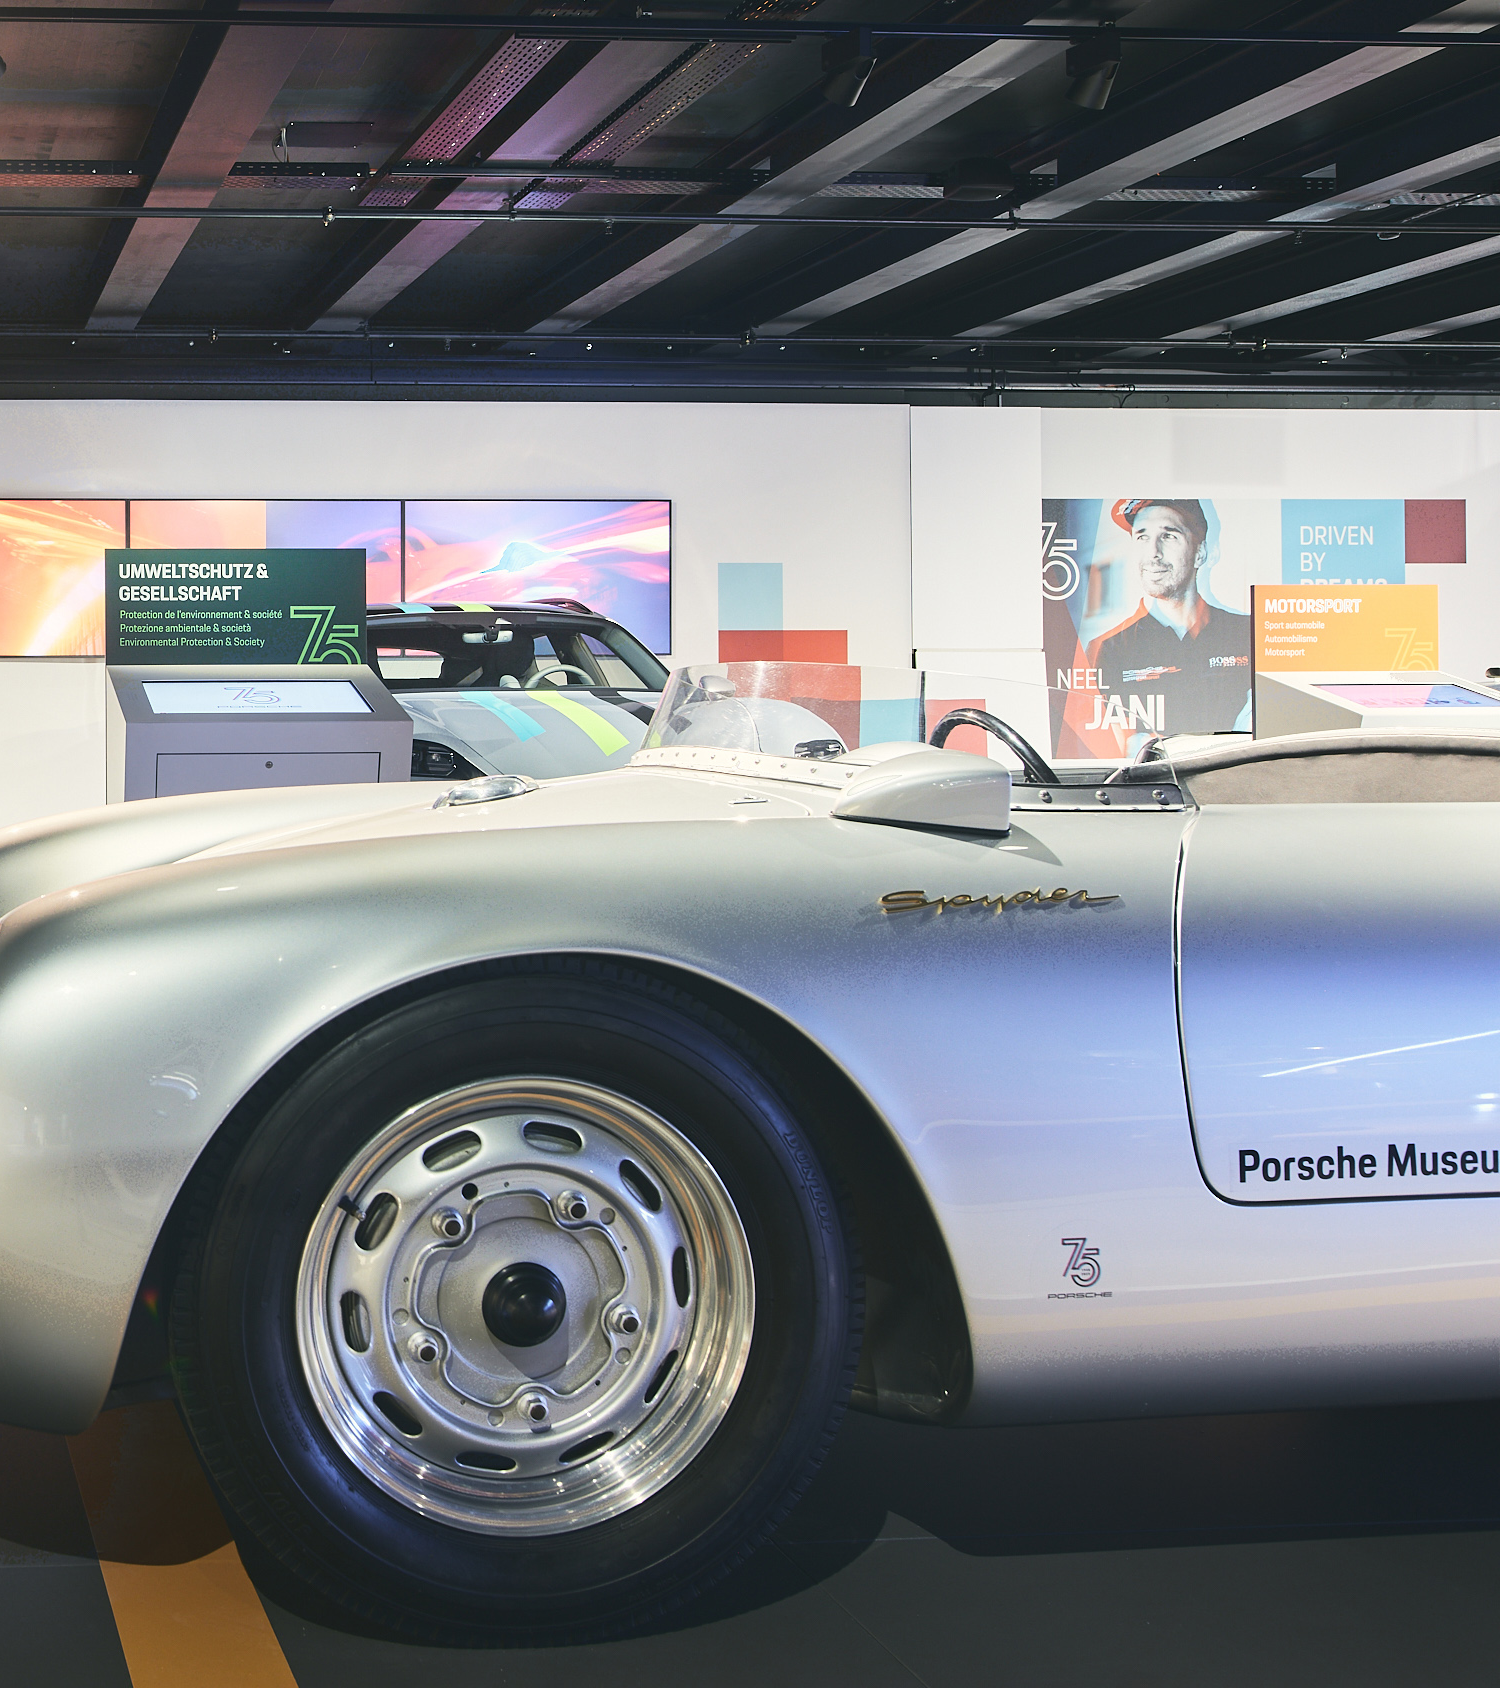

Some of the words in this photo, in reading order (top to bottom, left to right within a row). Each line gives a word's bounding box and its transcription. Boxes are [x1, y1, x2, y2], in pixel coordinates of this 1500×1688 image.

[1299, 525, 1374, 546] DRIVEN
[1300, 552, 1326, 572] BY
[119, 563, 254, 579] UMWELTSCHUTZ
[256, 563, 269, 579] &
[118, 585, 243, 602] GESELLSCHAFT
[119, 609, 163, 619] Protection
[164, 609, 175, 619] de
[177, 609, 242, 619] l'environnement
[244, 609, 251, 619] &
[252, 609, 283, 619] société
[1264, 598, 1362, 614] MOTORSPORT
[119, 623, 164, 633] Protezione
[165, 623, 212, 633] ambientale
[213, 623, 220, 633] &
[221, 623, 252, 633] società
[1264, 620, 1285, 631] Sport
[1285, 620, 1325, 630] automobile
[119, 637, 179, 647] Environmental
[180, 637, 224, 647] Protection
[225, 637, 232, 647] &
[233, 637, 265, 649] Society
[289, 605, 362, 665] 75
[1264, 634, 1318, 643] Automobilismo
[1264, 647, 1306, 658] Motorsport
[1384, 627, 1435, 671] 75
[1056, 668, 1110, 690] NEEL
[1084, 694, 1165, 732] JANI
[880, 886, 1121, 915] Spyder
[1238, 1145, 1378, 1184] Porsche
[1061, 1237, 1102, 1288] 75
[1047, 1291, 1113, 1300] PORSCHE
